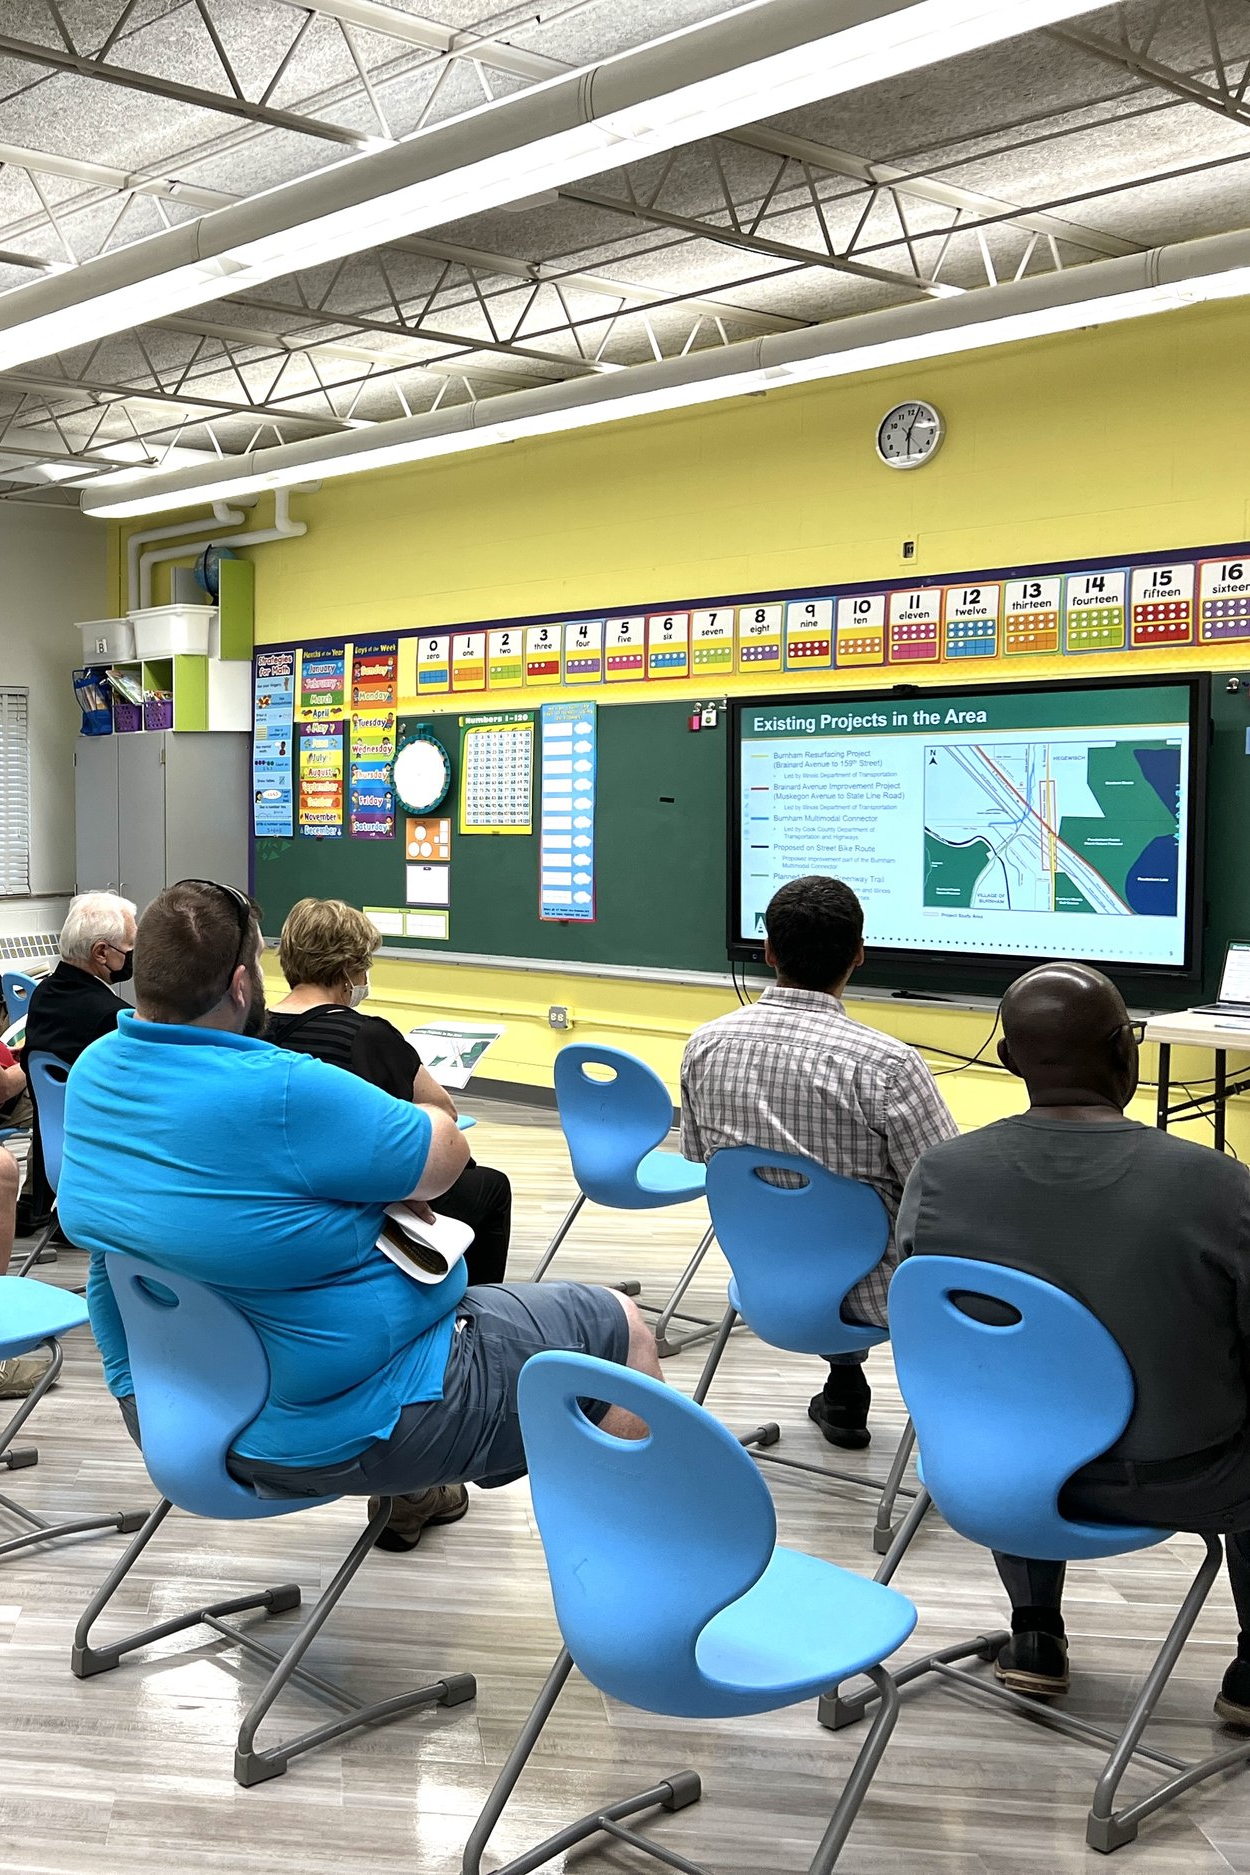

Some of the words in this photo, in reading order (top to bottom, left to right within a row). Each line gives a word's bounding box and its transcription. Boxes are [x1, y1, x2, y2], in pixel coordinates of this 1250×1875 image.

[1221, 564, 1243, 581] 16
[1152, 570, 1172, 587] 15
[1085, 576, 1105, 593] 14
[1023, 583, 1042, 599] 13
[1144, 587, 1180, 598] fifteen
[910, 595, 920, 609] 11
[963, 589, 981, 605] 12
[1073, 594, 1118, 606] fourteen
[854, 600, 871, 614] 10
[1012, 599, 1052, 610] thirteen
[755, 609, 765, 622] 8
[806, 605, 815, 617] 9
[899, 611, 930, 620] eleven
[955, 607, 987, 616] twelve
[664, 618, 672, 630] 6
[709, 614, 717, 626] 7
[800, 619, 818, 628] nine
[854, 616, 867, 624] ten
[580, 626, 587, 638] 4
[621, 622, 629, 633] 5
[702, 628, 723, 636] seven
[750, 625, 770, 634] eight
[502, 634, 509, 645] 2
[540, 629, 548, 641] 3
[618, 635, 631, 643] five
[430, 640, 437, 651] 0
[467, 637, 470, 648] 1
[576, 640, 590, 648] four
[259, 654, 292, 666] Strategies
[259, 667, 271, 677] for
[272, 665, 290, 675] Math
[309, 664, 336, 674] January
[358, 690, 389, 702] Monday
[313, 710, 329, 718] April
[358, 718, 386, 727] Tuesday
[754, 716, 815, 733] Existing
[821, 713, 887, 731] Projects
[893, 711, 907, 726] in
[913, 710, 940, 724] the
[945, 709, 987, 723] Area
[312, 723, 328, 734] May
[352, 745, 393, 753] Wednesday
[312, 754, 327, 762] July
[774, 761, 803, 769] (Brainard
[309, 768, 331, 777] August
[355, 769, 387, 779] Thursday
[830, 783, 873, 791] Improvement
[359, 796, 383, 807] Friday
[305, 813, 336, 821] November
[304, 825, 337, 835] December
[354, 822, 388, 832] Saturday
[774, 844, 804, 852] Proposed
